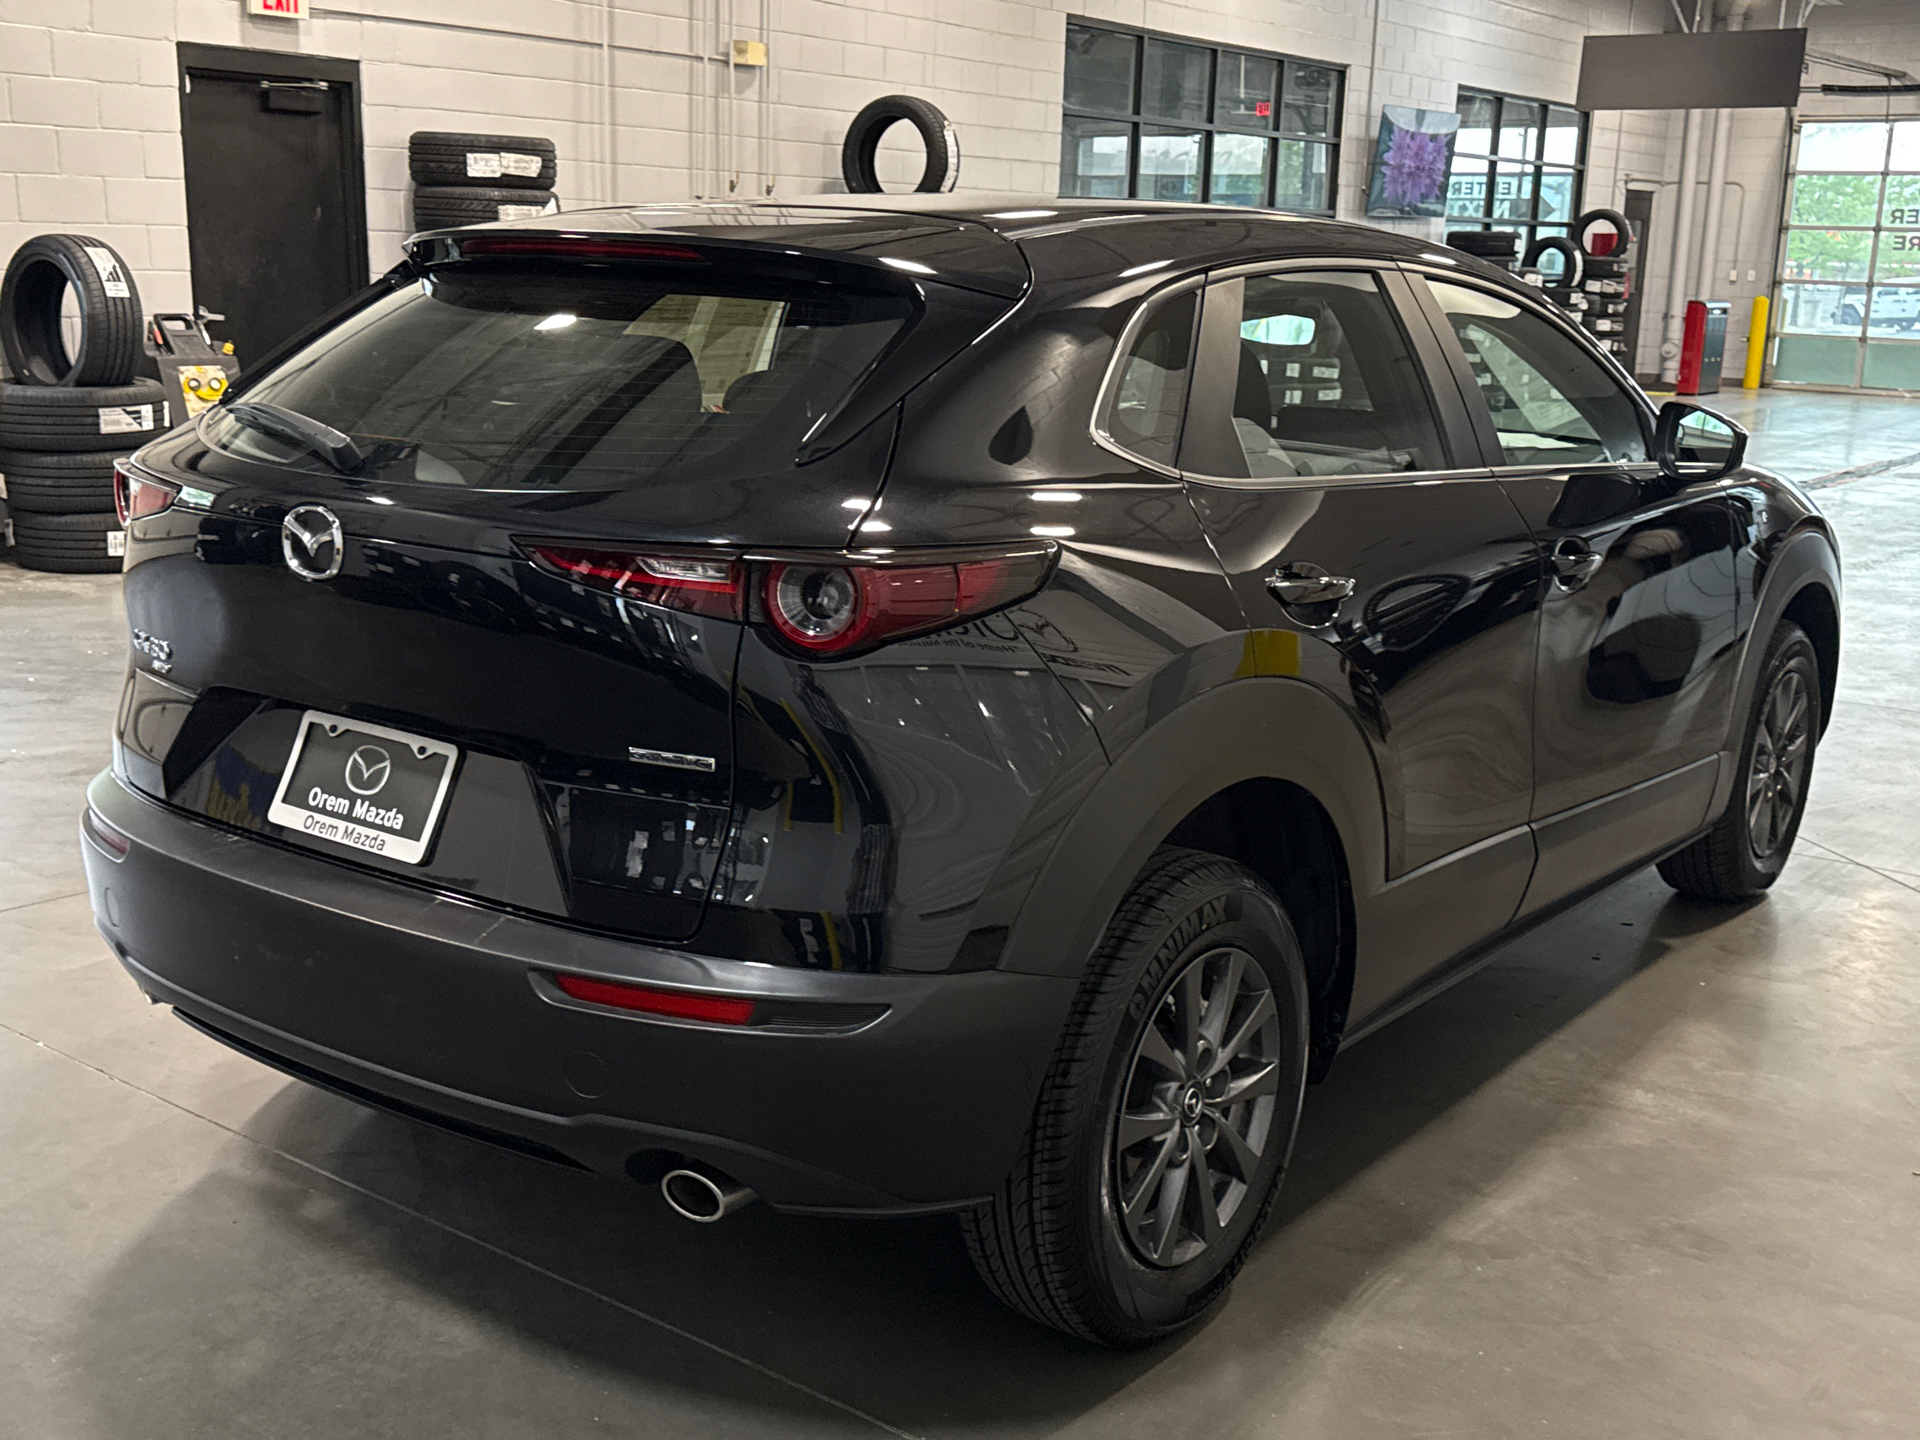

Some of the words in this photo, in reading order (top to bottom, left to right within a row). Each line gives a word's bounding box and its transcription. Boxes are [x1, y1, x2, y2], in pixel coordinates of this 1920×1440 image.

[308, 786, 350, 816] Orem
[352, 798, 404, 830] Mazda
[303, 814, 339, 838] Orem
[341, 825, 387, 852] Mazda
